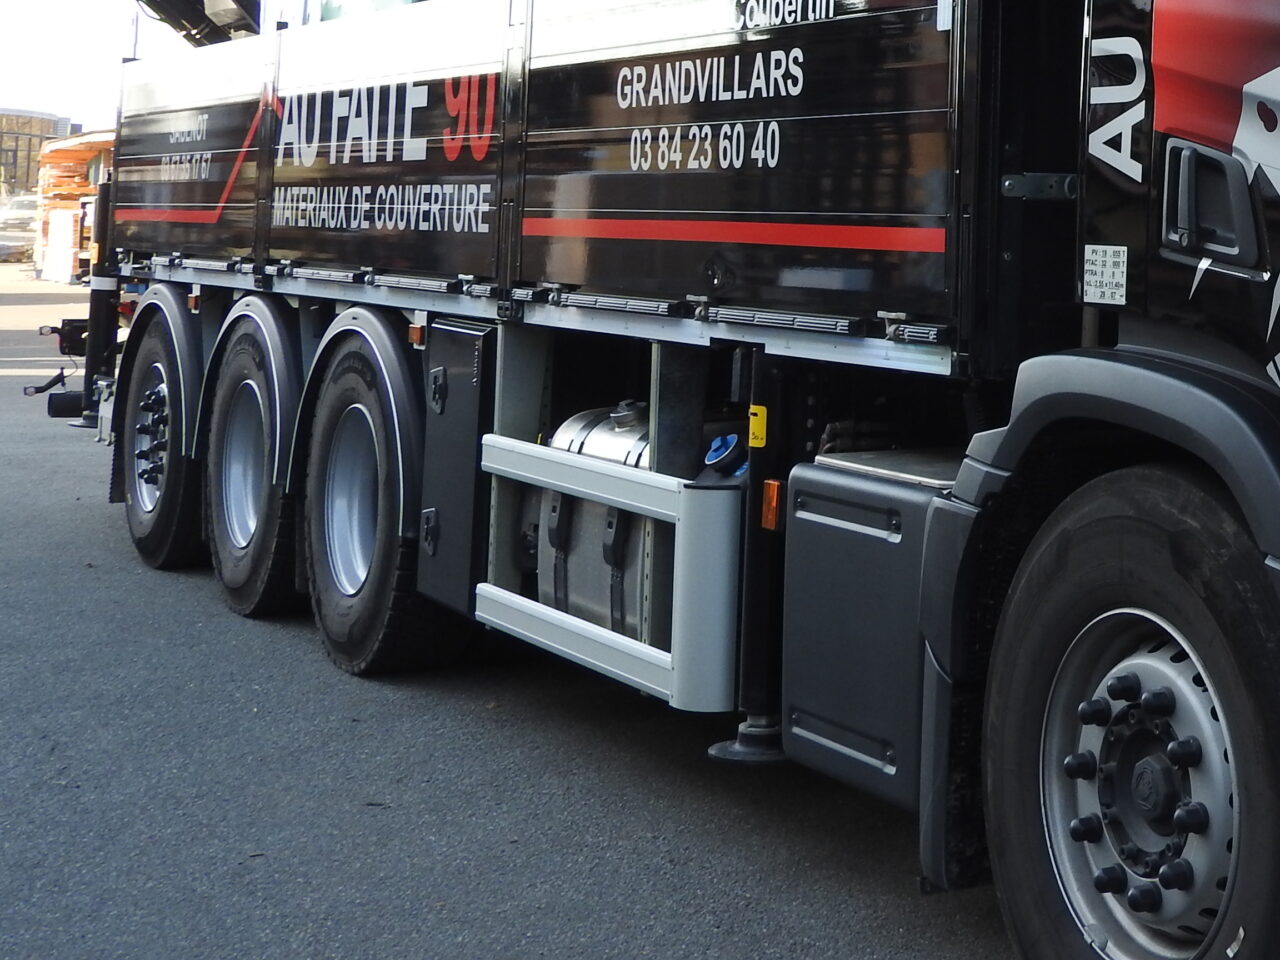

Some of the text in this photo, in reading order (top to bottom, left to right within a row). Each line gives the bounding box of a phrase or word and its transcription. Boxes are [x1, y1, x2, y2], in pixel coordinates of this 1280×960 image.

[616, 47, 804, 109] GRANDVILLARS
[276, 91, 322, 167] AU
[442, 73, 496, 162] 90
[1089, 36, 1147, 183] AU
[629, 120, 780, 171] 03 84 23 60 40
[272, 183, 492, 233] MATERIAUX DE COUVERTURE
